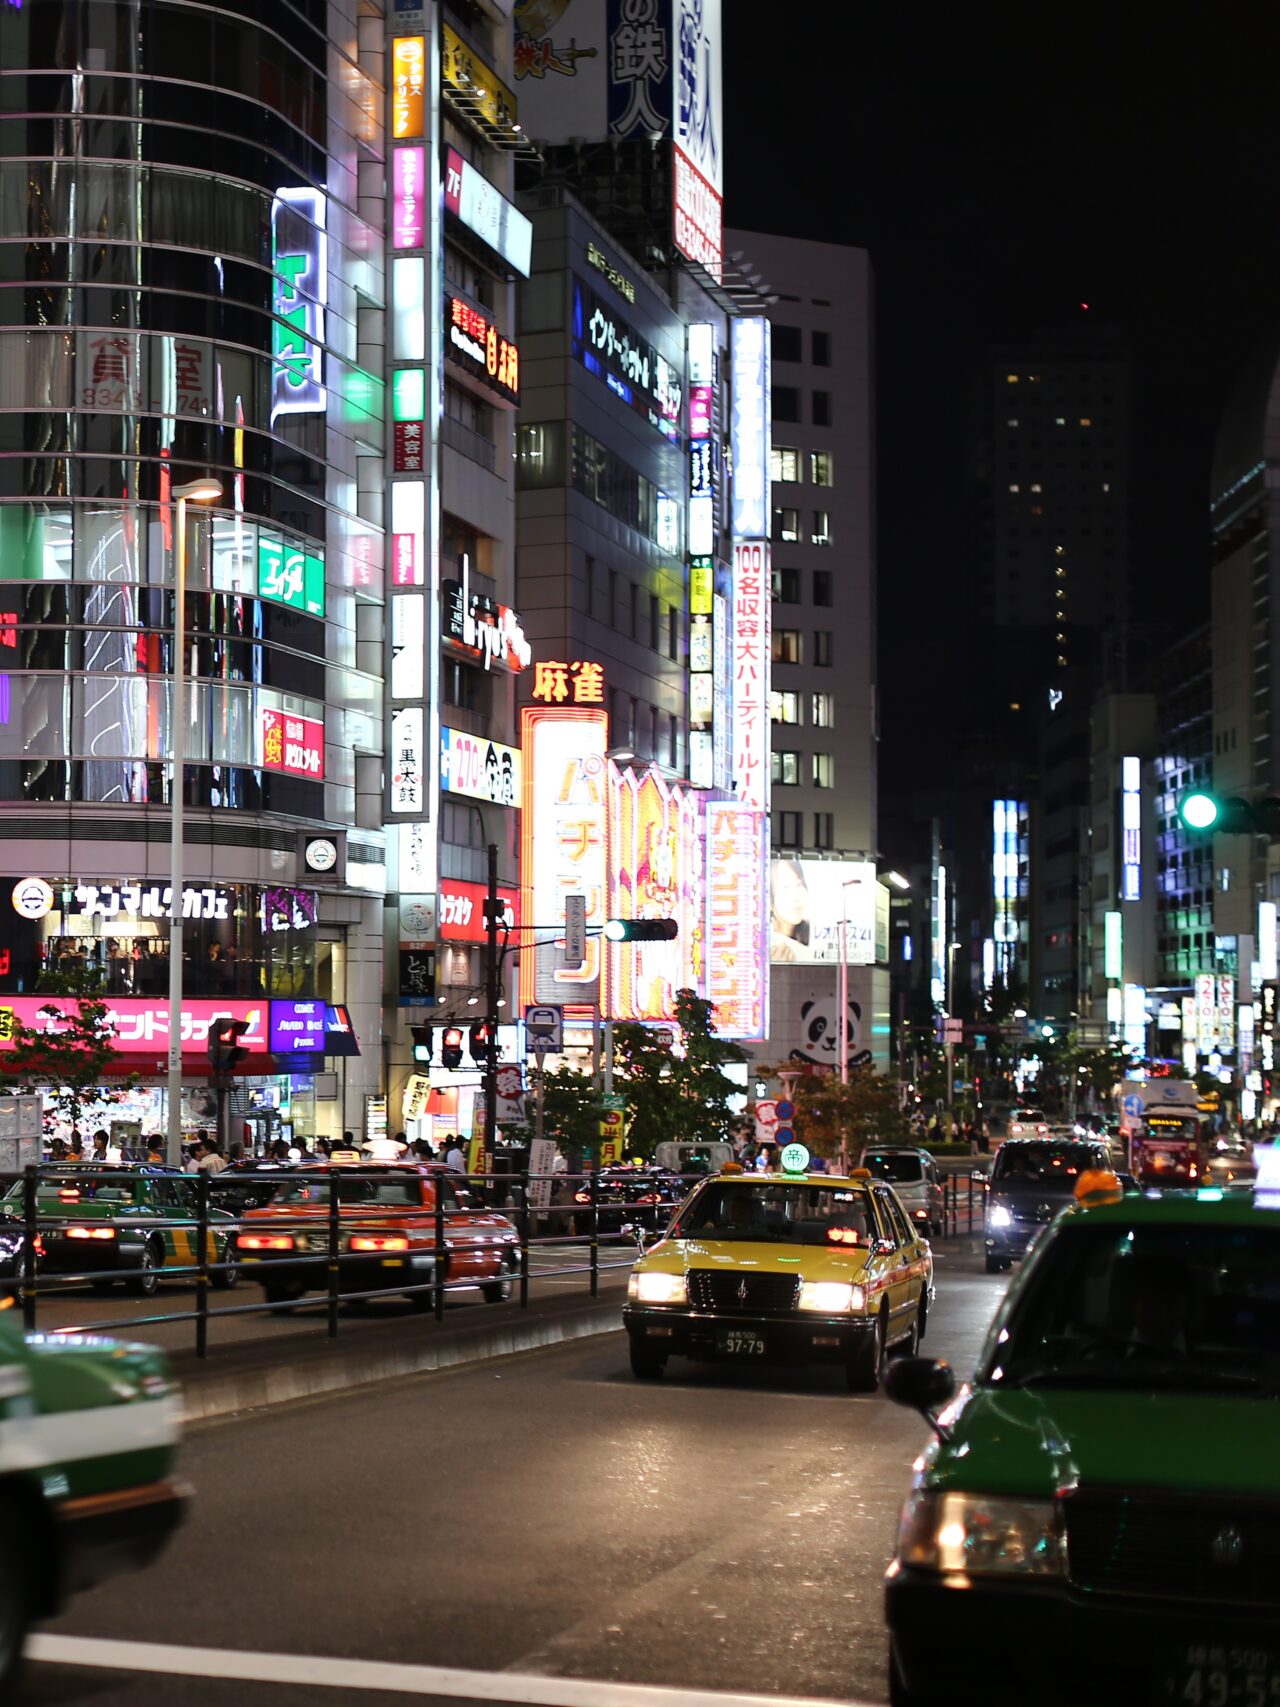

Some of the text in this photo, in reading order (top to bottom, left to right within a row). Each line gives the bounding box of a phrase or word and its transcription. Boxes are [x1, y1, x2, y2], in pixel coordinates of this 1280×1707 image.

[447, 167, 461, 198] 7F
[404, 423, 420, 470] 美容室
[532, 661, 604, 702] 麻雀
[399, 748, 417, 804] 黒太鼓
[456, 738, 478, 788] 270
[553, 754, 605, 984] パチンコ
[726, 1339, 764, 1353] 97-79
